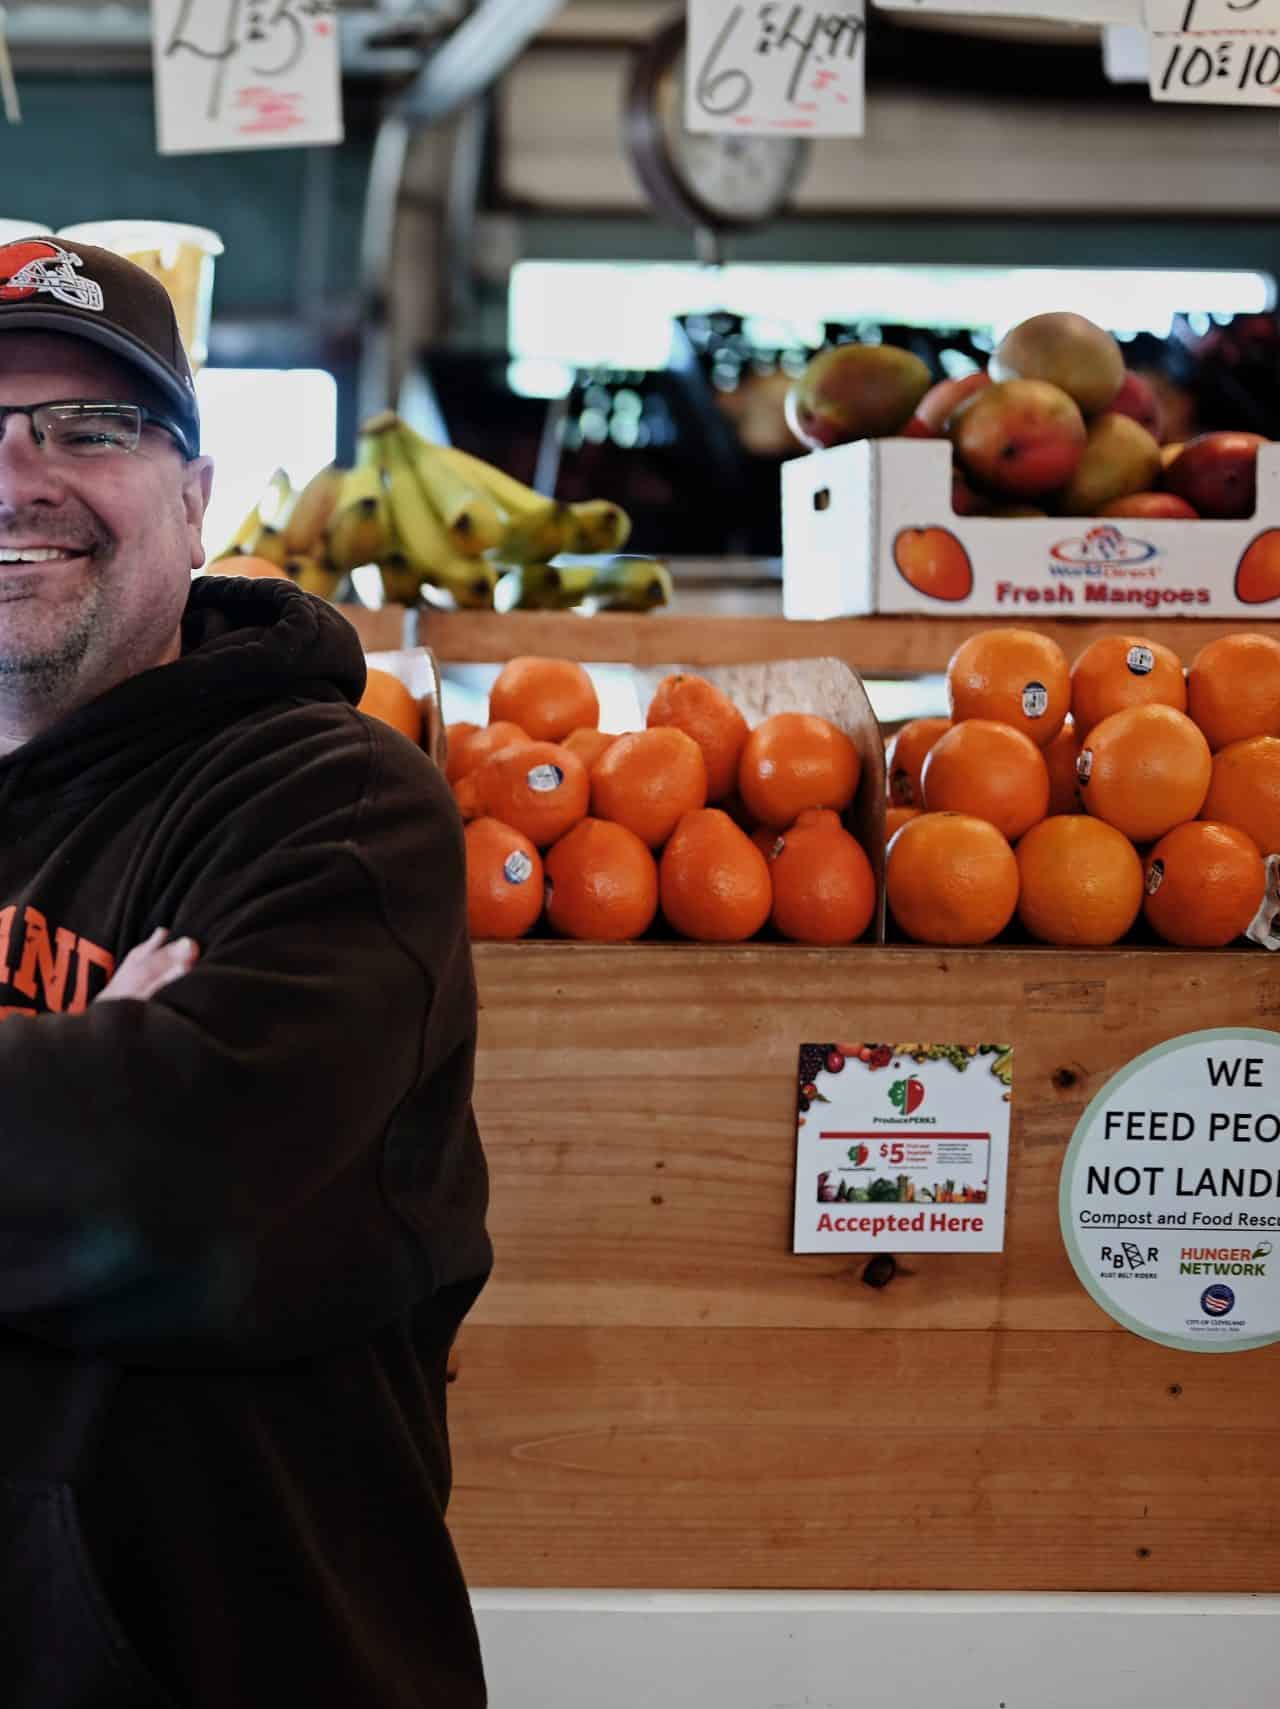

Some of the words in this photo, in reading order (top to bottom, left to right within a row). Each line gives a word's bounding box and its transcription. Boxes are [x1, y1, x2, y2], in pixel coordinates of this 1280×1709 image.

[164, 0, 241, 122] 4
[695, 4, 753, 117] 6
[1160, 43, 1213, 91] 10
[995, 582, 1073, 604] Fresh
[1083, 582, 1210, 608] Mangoes
[1207, 1057, 1264, 1087] WE
[1104, 1111, 1195, 1140] FEED
[1209, 1113, 1280, 1142] PEO
[880, 1143, 905, 1164] $5
[1087, 1166, 1164, 1195] NOT
[1176, 1167, 1280, 1197] LAND
[816, 1212, 925, 1237] Accepted
[929, 1213, 984, 1232] Here
[1079, 1210, 1152, 1228] Compost
[1157, 1211, 1187, 1225] and
[1192, 1212, 1233, 1226] Food
[1180, 1248, 1251, 1261] HUNGER
[1179, 1263, 1265, 1276] NETWORK
